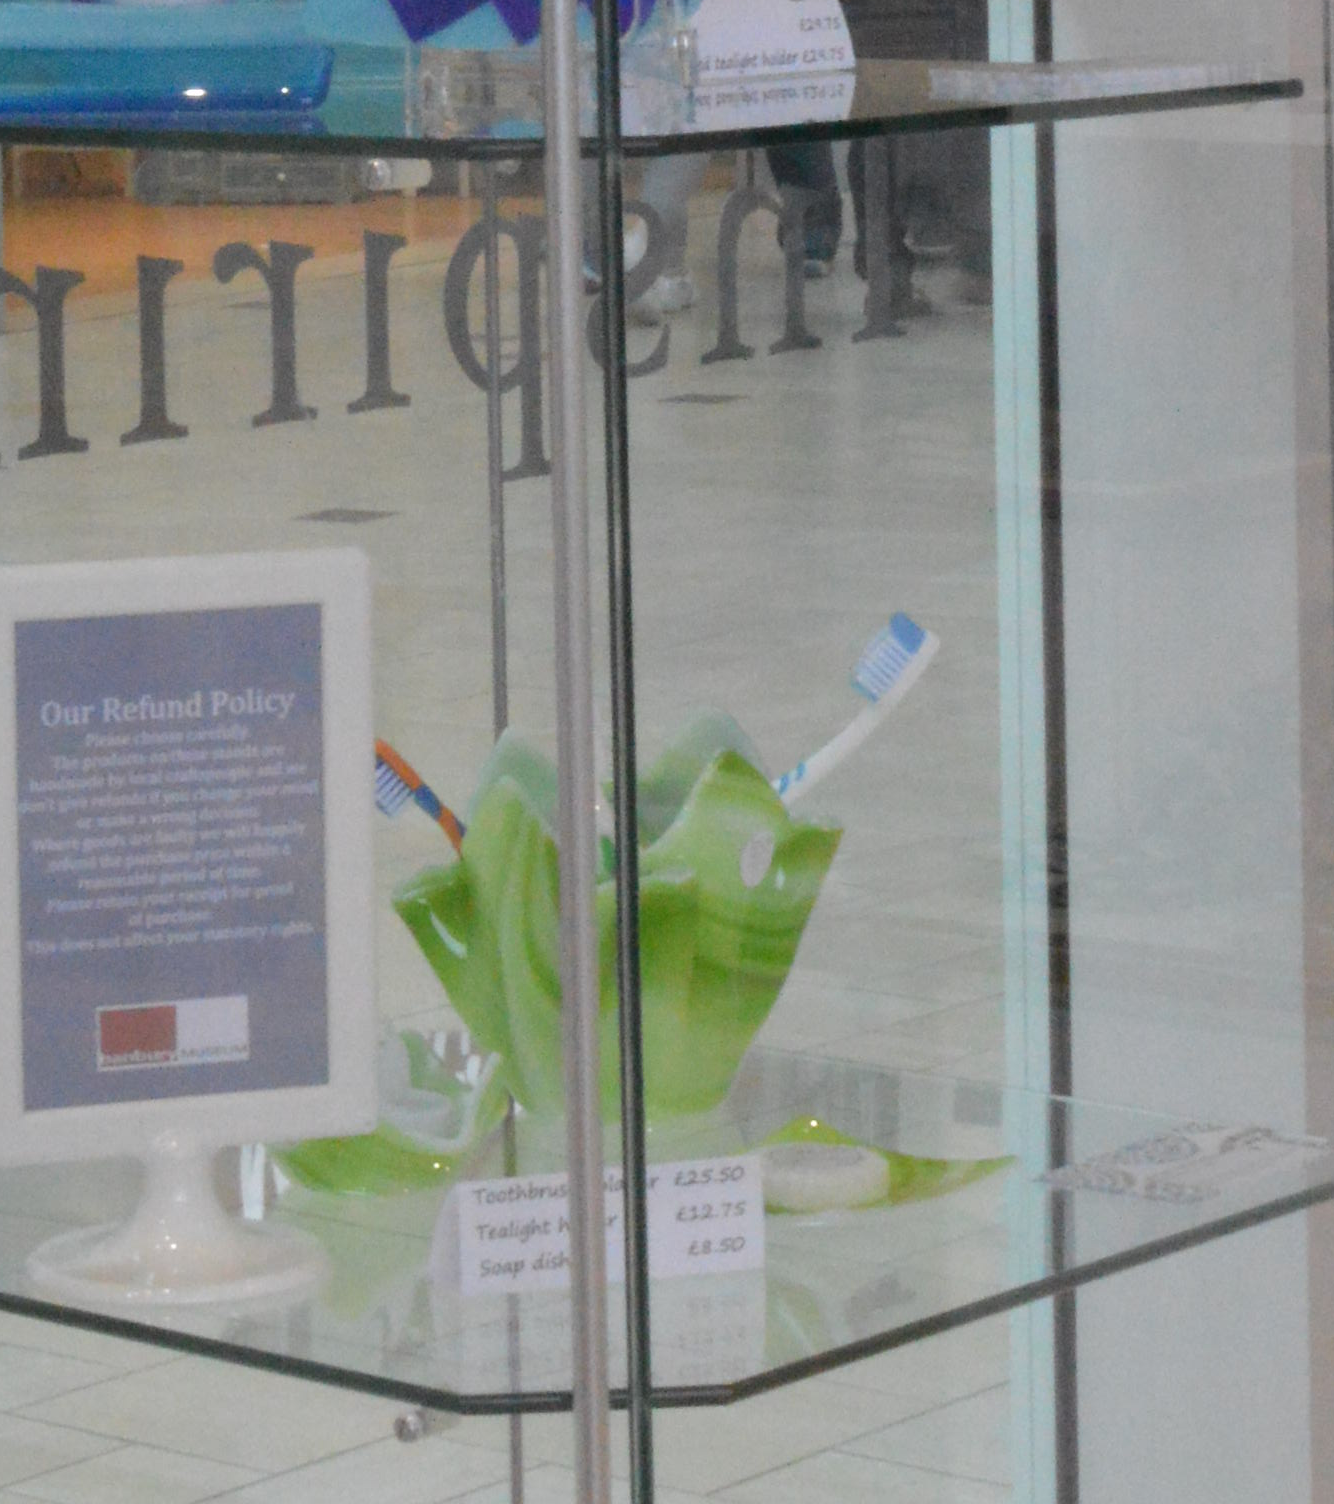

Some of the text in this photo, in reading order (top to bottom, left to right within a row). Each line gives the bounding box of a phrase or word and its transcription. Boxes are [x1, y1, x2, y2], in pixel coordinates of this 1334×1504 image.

[40, 688, 296, 728] Our Refund Policy
[474, 1181, 570, 1205] Toothbrus
[674, 1165, 745, 1188] £25.50
[475, 1217, 552, 1245] Tealight
[675, 1201, 747, 1222] £12.75
[480, 1259, 525, 1281] Soap
[687, 1235, 746, 1258] £8.50
